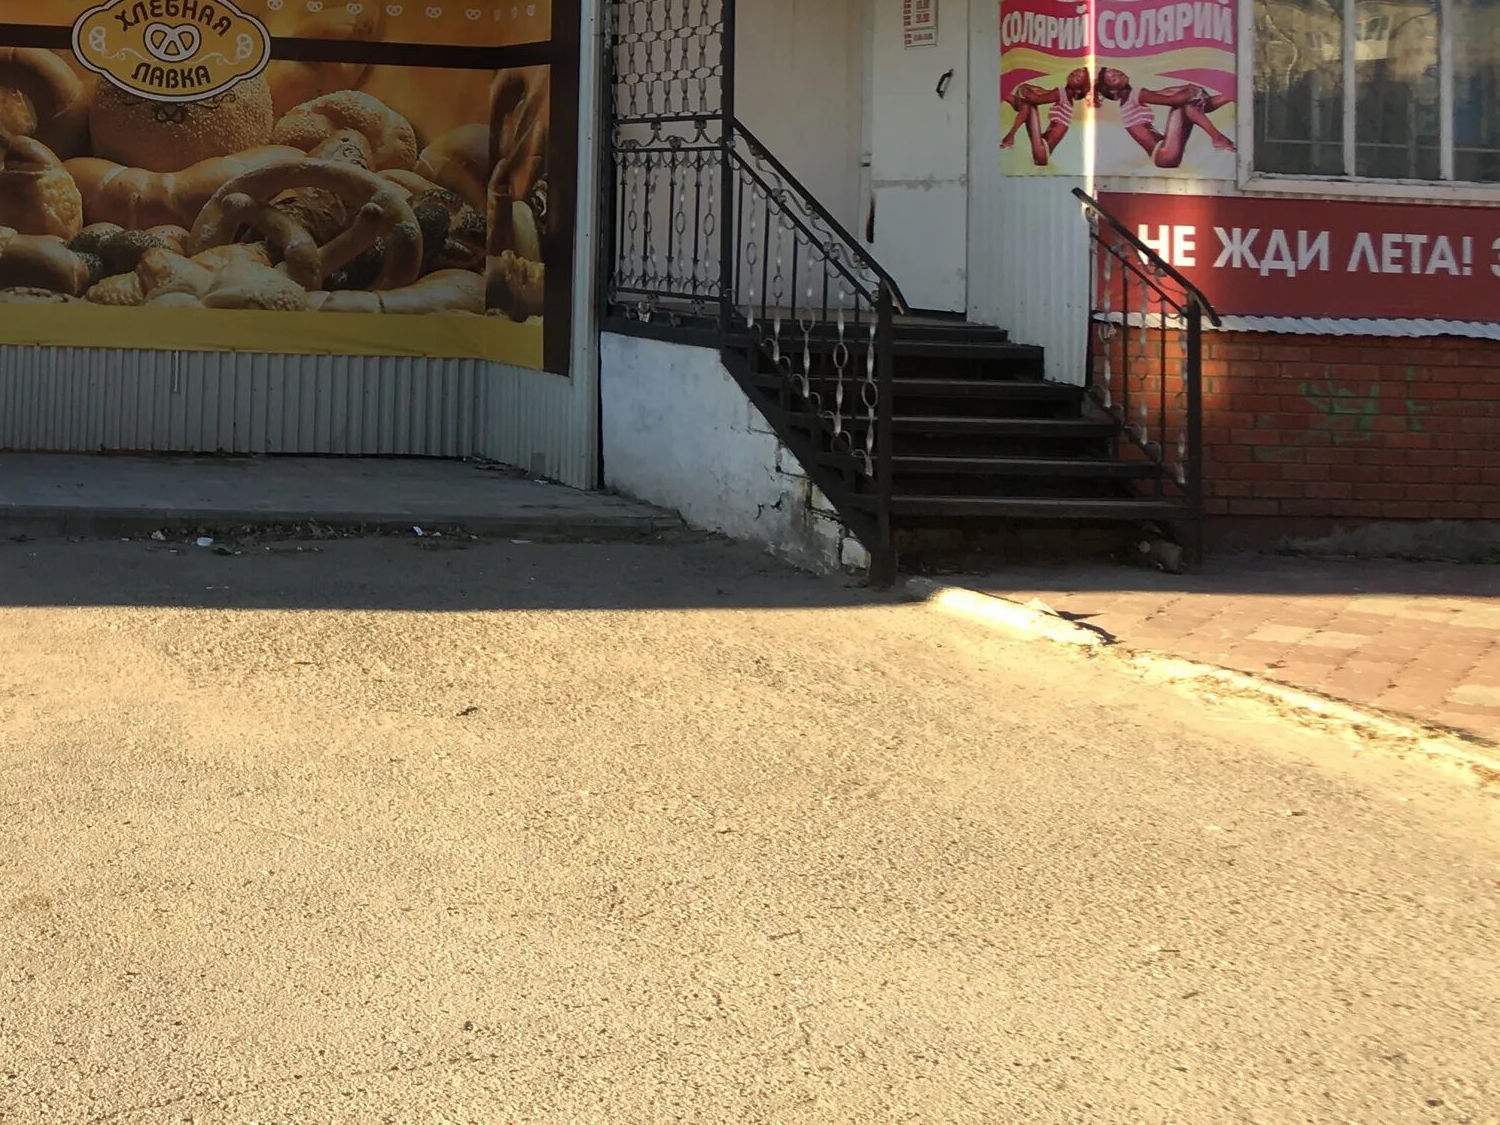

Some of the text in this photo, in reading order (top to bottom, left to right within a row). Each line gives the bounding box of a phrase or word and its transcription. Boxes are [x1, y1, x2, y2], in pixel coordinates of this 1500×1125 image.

[1001, 4, 1090, 51] СОЛЯРИЙ
[130, 61, 212, 90] ЛАВКА
[1138, 224, 1197, 268] НЕ
[1212, 226, 1331, 278] ЖДИ
[1347, 232, 1473, 276] ЛЕТА!
